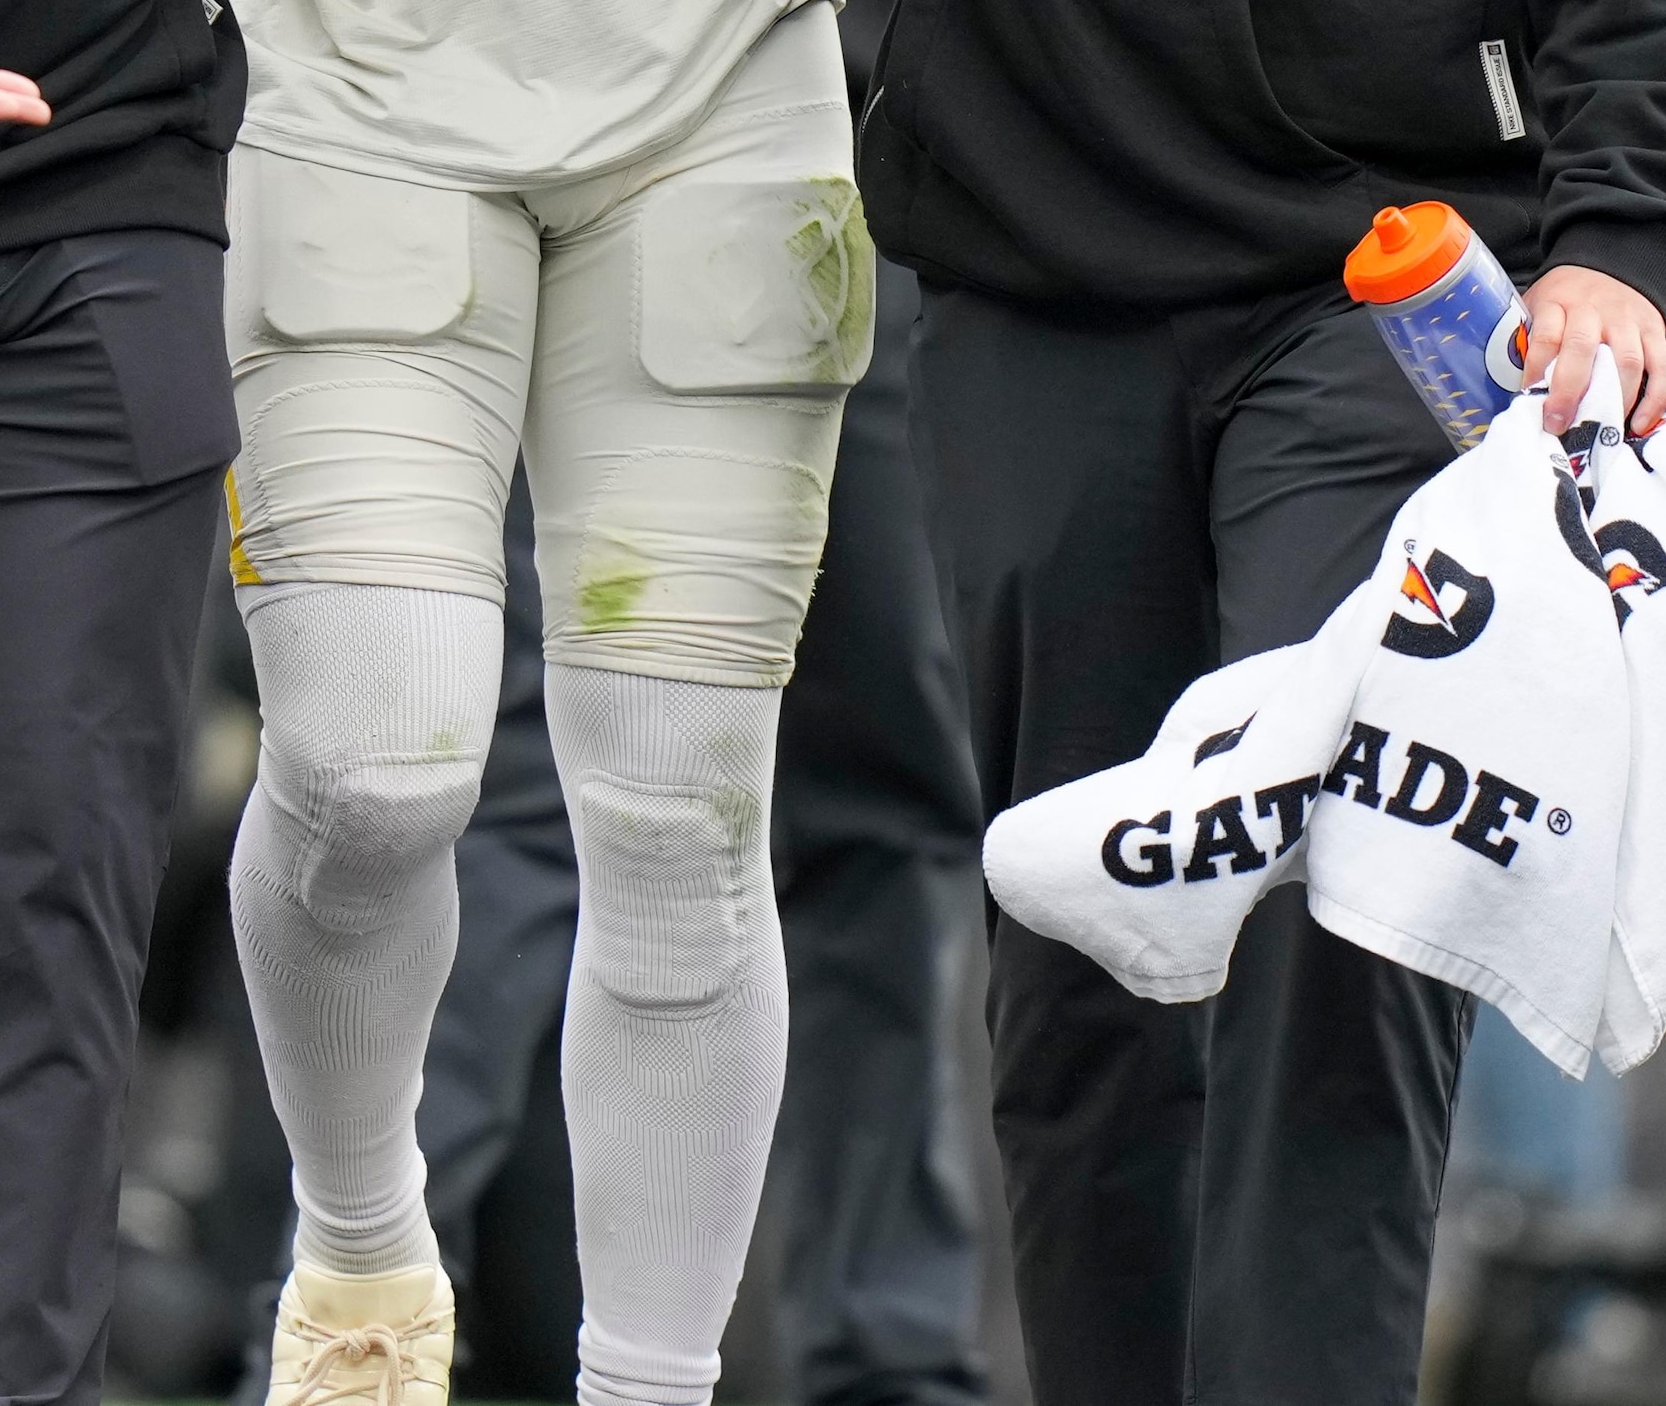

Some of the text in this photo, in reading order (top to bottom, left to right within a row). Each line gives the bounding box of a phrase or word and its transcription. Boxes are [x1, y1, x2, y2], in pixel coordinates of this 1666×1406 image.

[1493, 58, 1516, 131] NIKE STANDARD ISSUE
